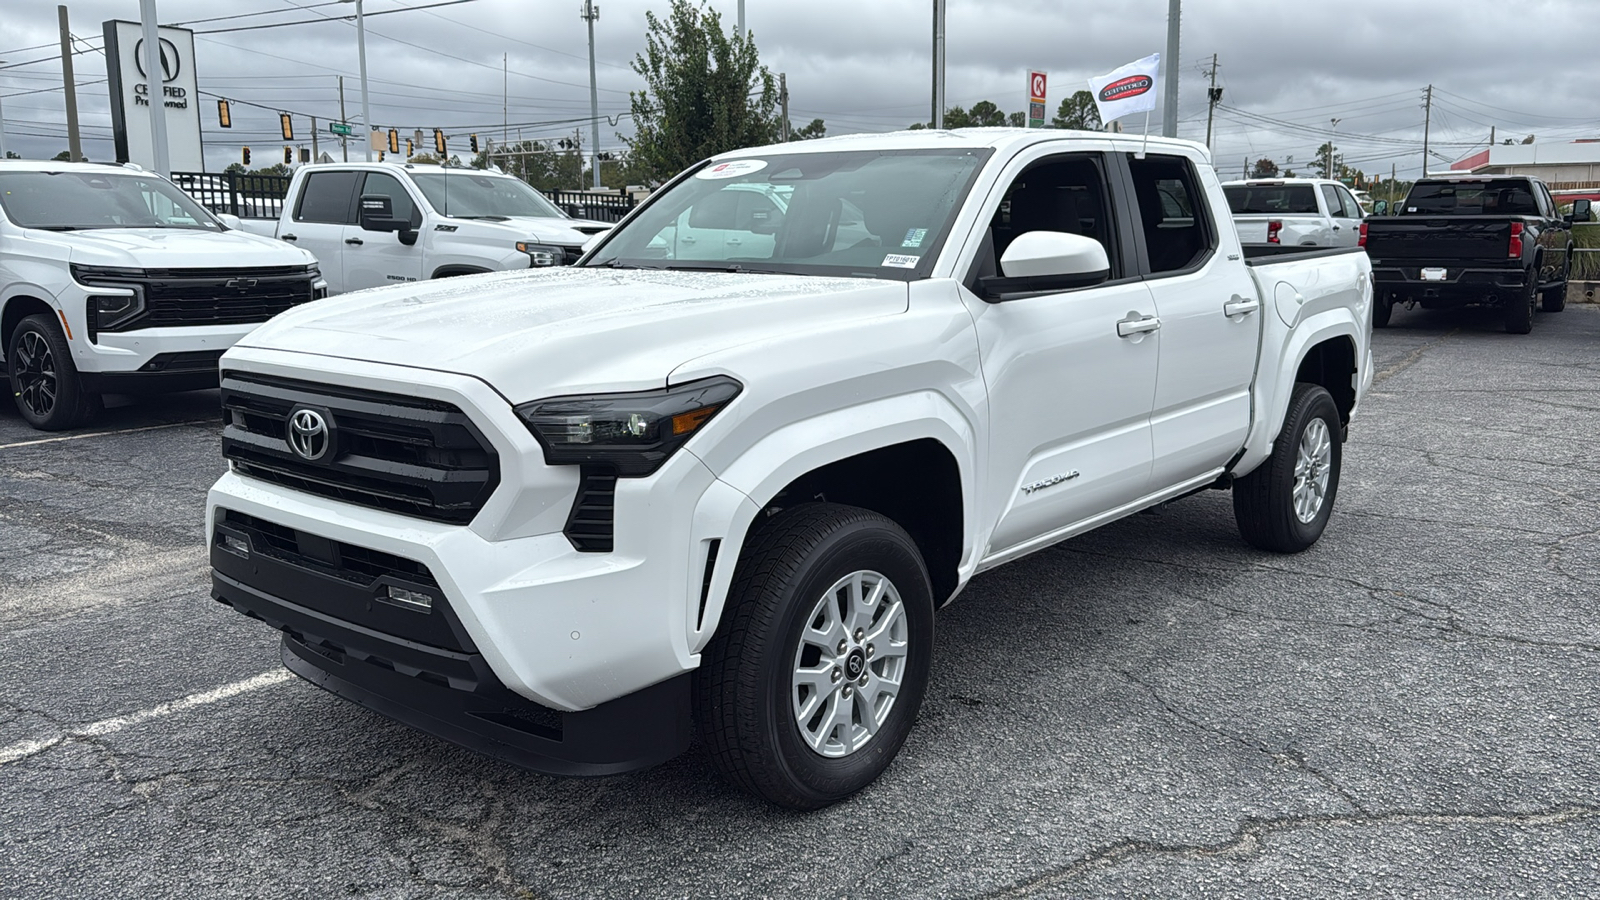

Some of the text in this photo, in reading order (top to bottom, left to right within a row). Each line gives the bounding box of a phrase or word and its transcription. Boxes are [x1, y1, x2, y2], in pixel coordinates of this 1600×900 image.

[134, 83, 187, 98] CEFIED
[134, 95, 188, 109] Prewned
[1021, 469, 1080, 495] TACOMA
